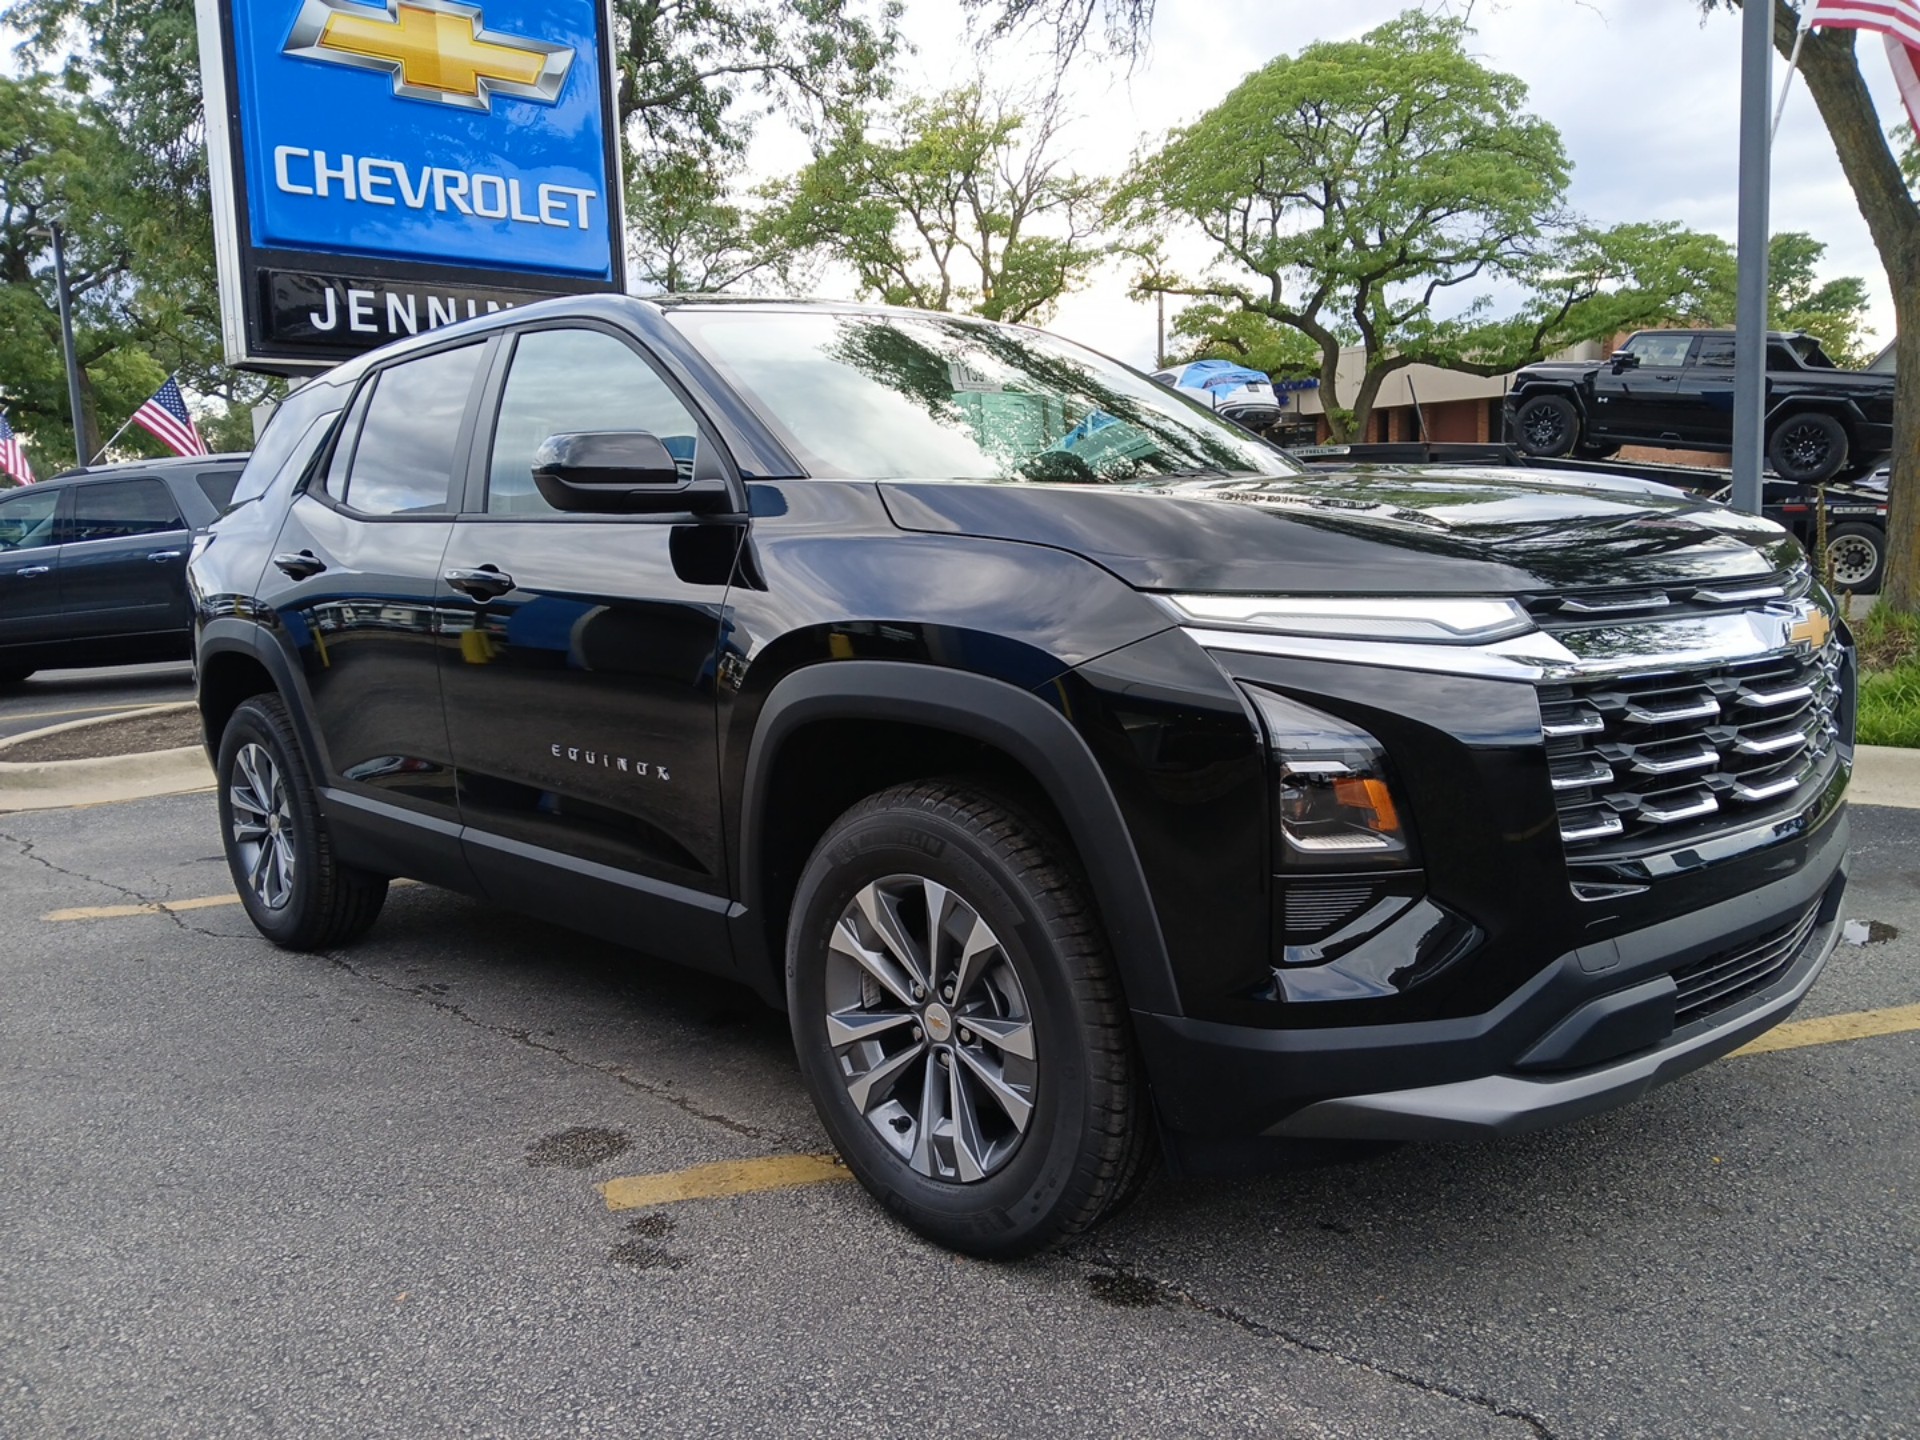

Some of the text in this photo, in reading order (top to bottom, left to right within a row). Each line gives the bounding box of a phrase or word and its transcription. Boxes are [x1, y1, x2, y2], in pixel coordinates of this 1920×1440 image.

[275, 145, 596, 229] CHEVROLET
[309, 287, 514, 334] JENN
[551, 744, 670, 781] EQUINOX
